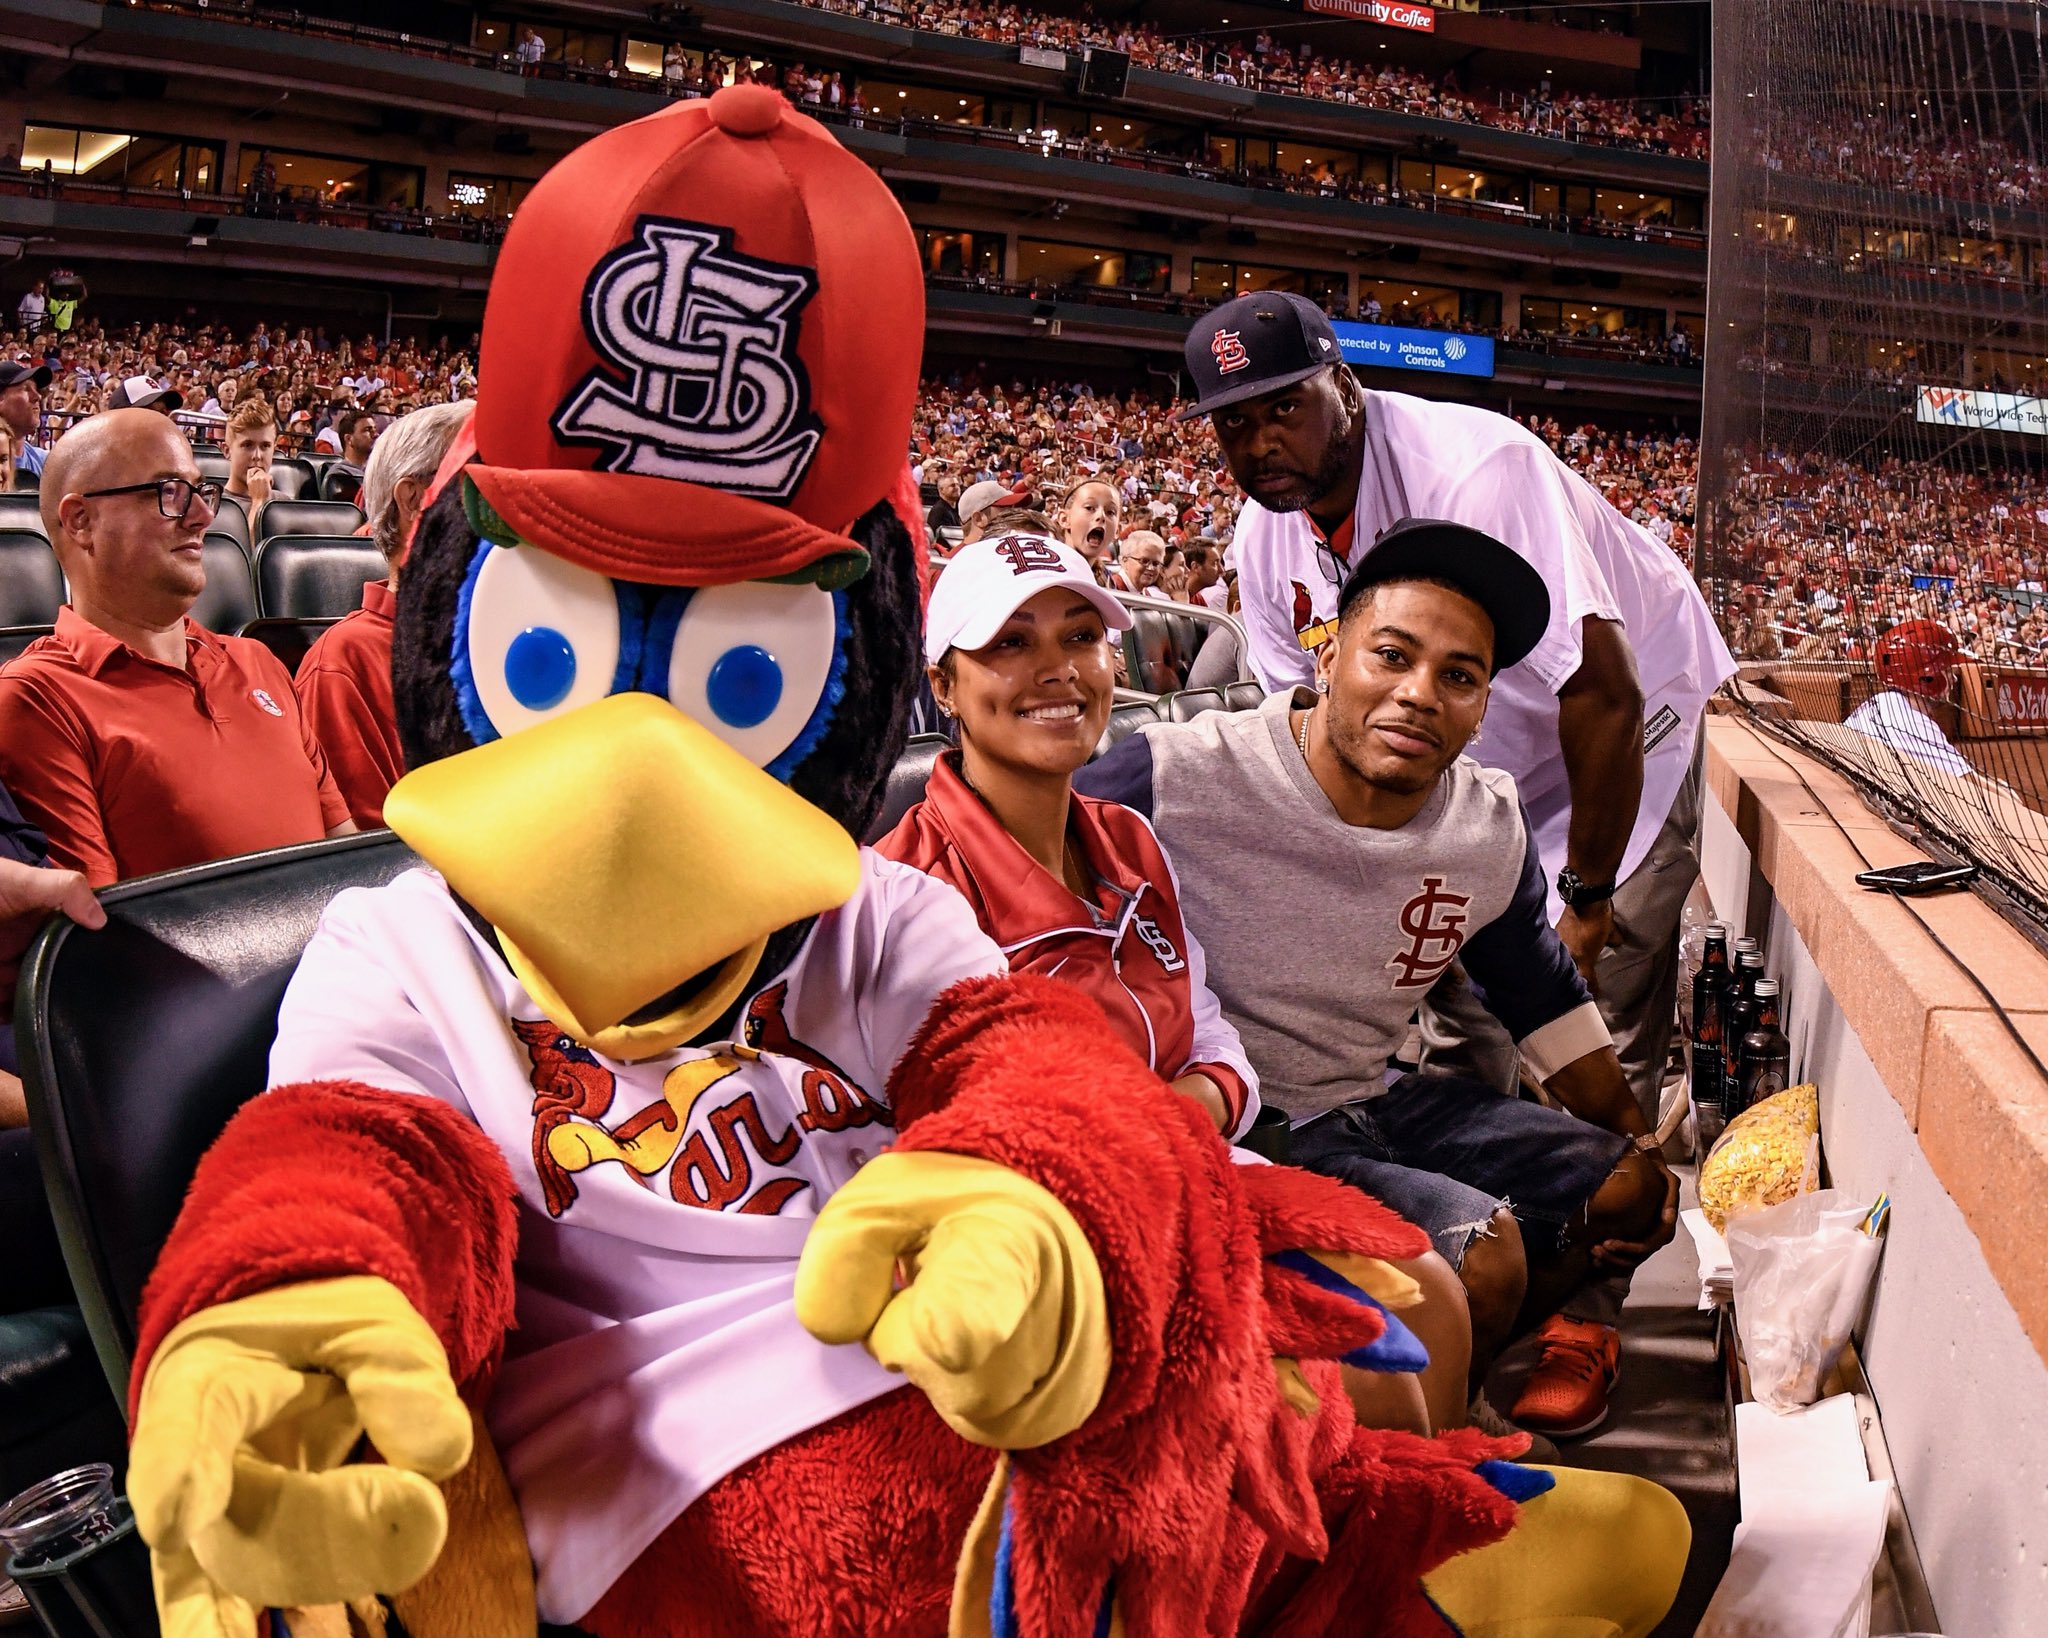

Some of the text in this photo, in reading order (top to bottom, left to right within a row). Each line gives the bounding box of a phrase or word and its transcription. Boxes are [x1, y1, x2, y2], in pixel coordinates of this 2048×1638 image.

[1391, 8, 1431, 28] Coffee
[1337, 338, 1438, 356] rotected by Johnson
[1405, 355, 1446, 368] Controls
[1964, 405, 1994, 418] World
[1996, 409, 2024, 421] Wide
